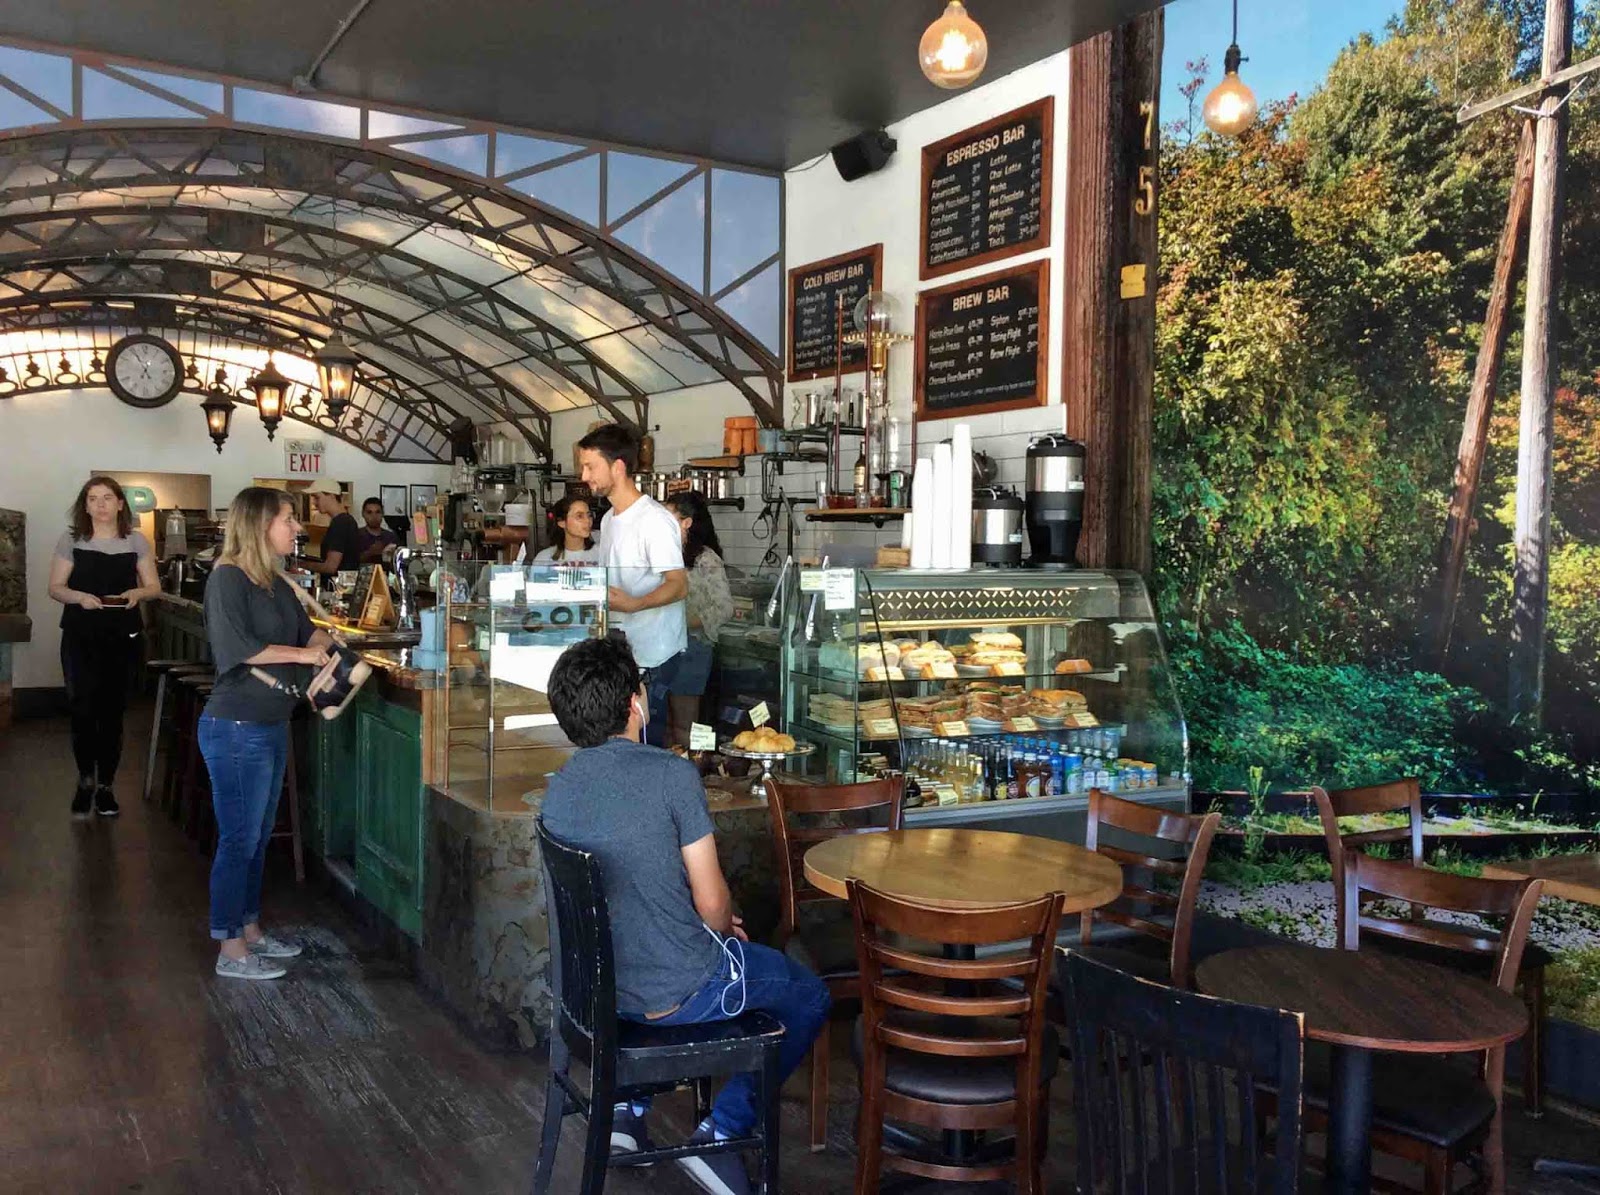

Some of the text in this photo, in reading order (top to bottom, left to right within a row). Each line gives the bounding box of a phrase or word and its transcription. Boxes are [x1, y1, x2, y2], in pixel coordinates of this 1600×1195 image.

[946, 124, 1026, 167] ESPRESSO BAR
[803, 275, 823, 290] COLD
[824, 269, 847, 285] BREW
[847, 263, 864, 279] BAR
[953, 285, 1010, 312] BREW BAR
[290, 453, 321, 473] EXIT
